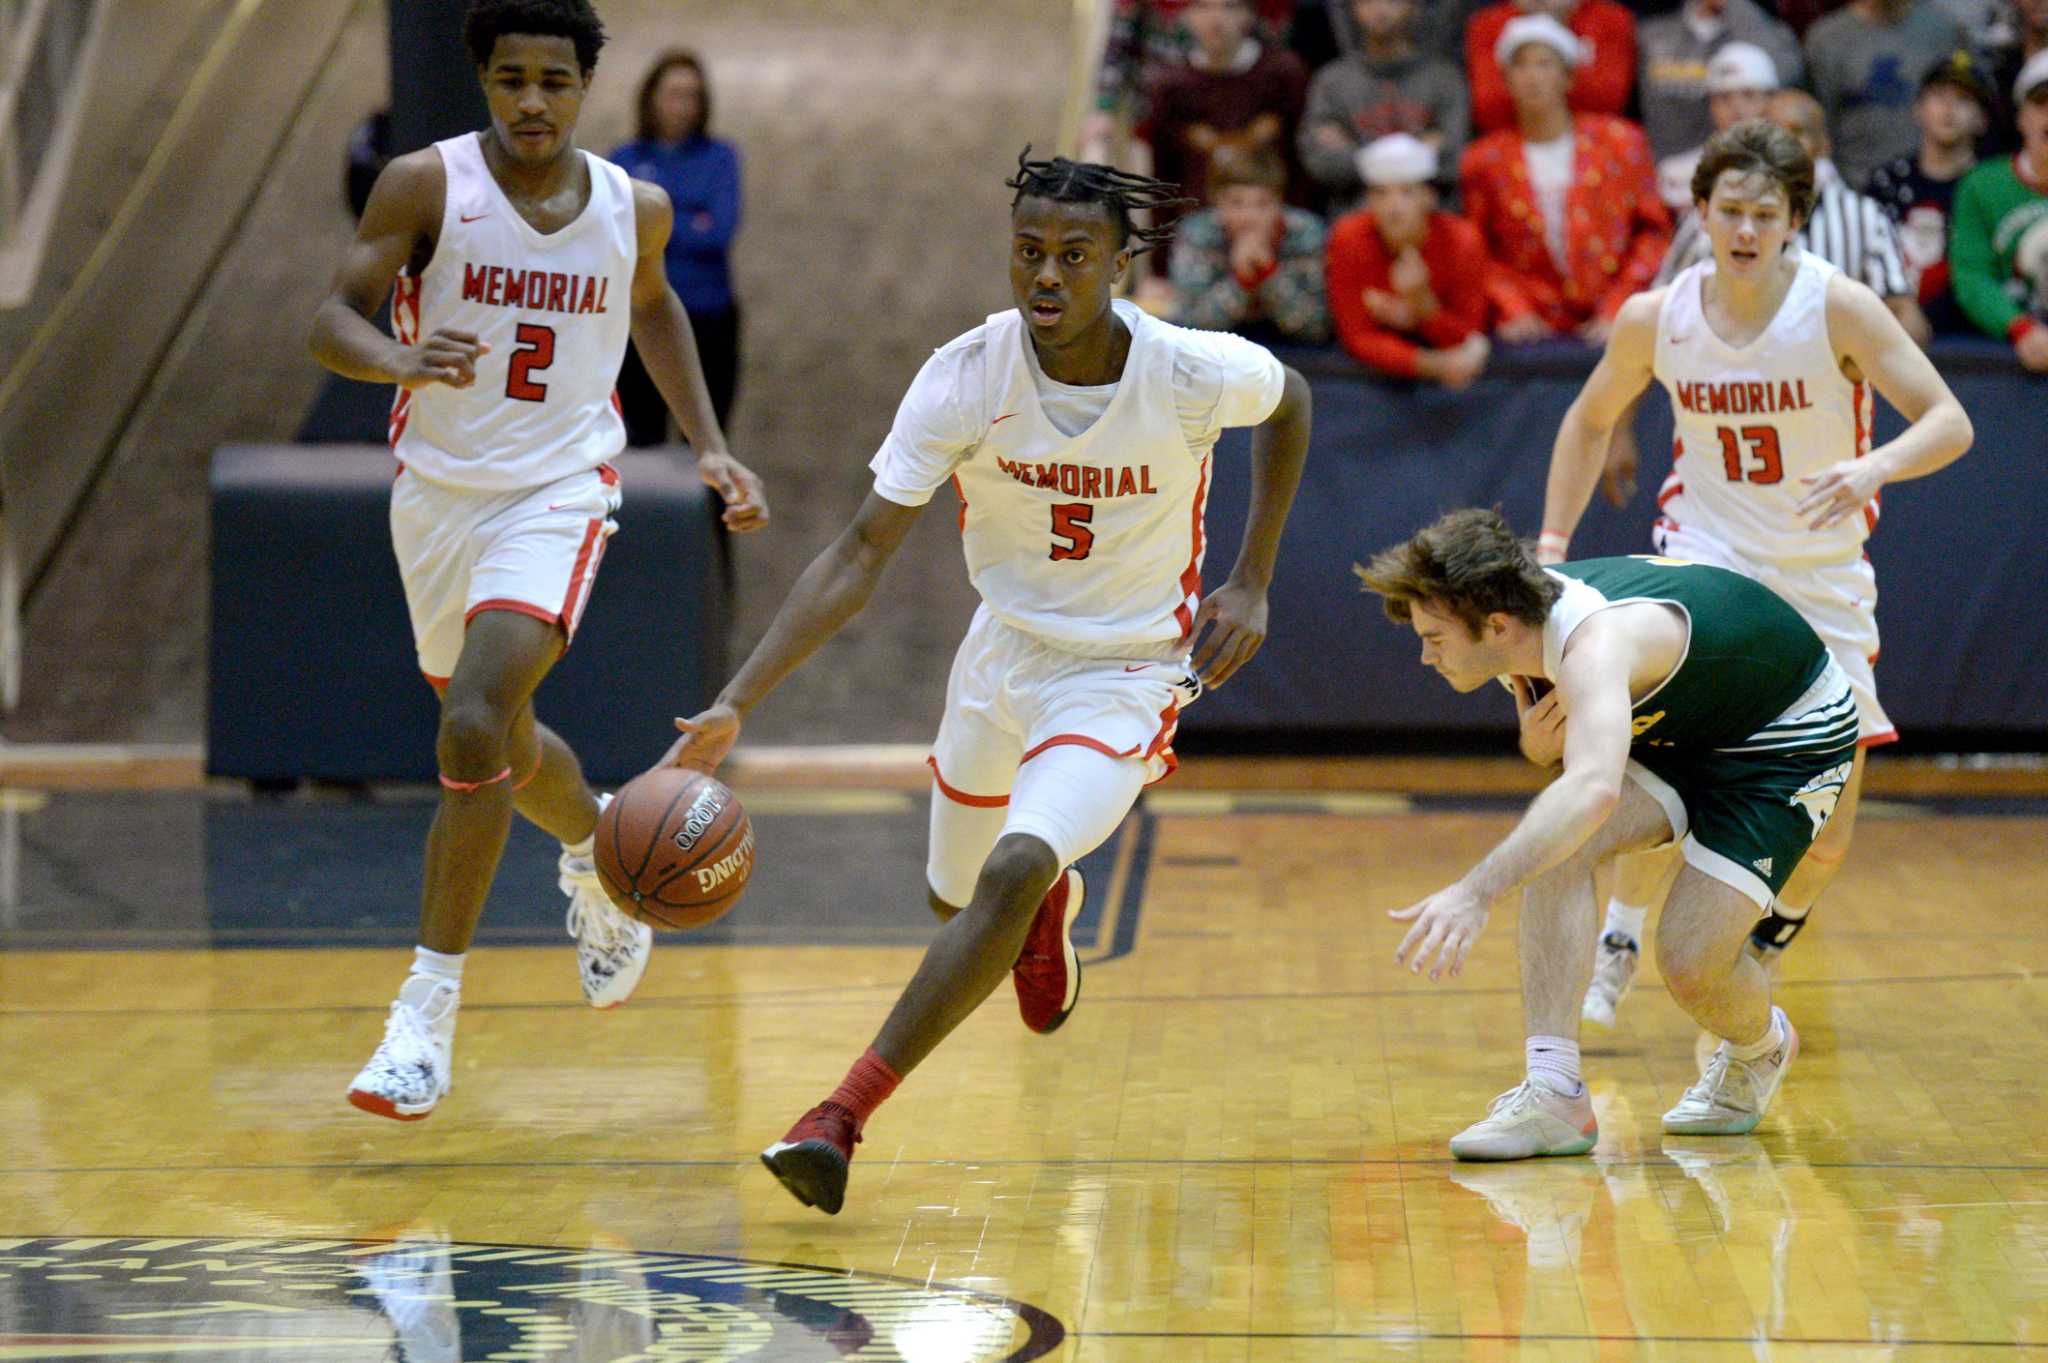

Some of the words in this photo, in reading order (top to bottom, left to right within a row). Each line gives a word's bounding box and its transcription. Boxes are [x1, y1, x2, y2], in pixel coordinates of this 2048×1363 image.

[462, 262, 608, 314] MEMORIAL
[505, 322, 556, 403] 2
[1677, 378, 1813, 414] MEMORIAL
[996, 455, 1157, 498] MEMORIAL
[1716, 424, 1785, 485] 13
[1049, 503, 1096, 562] 5
